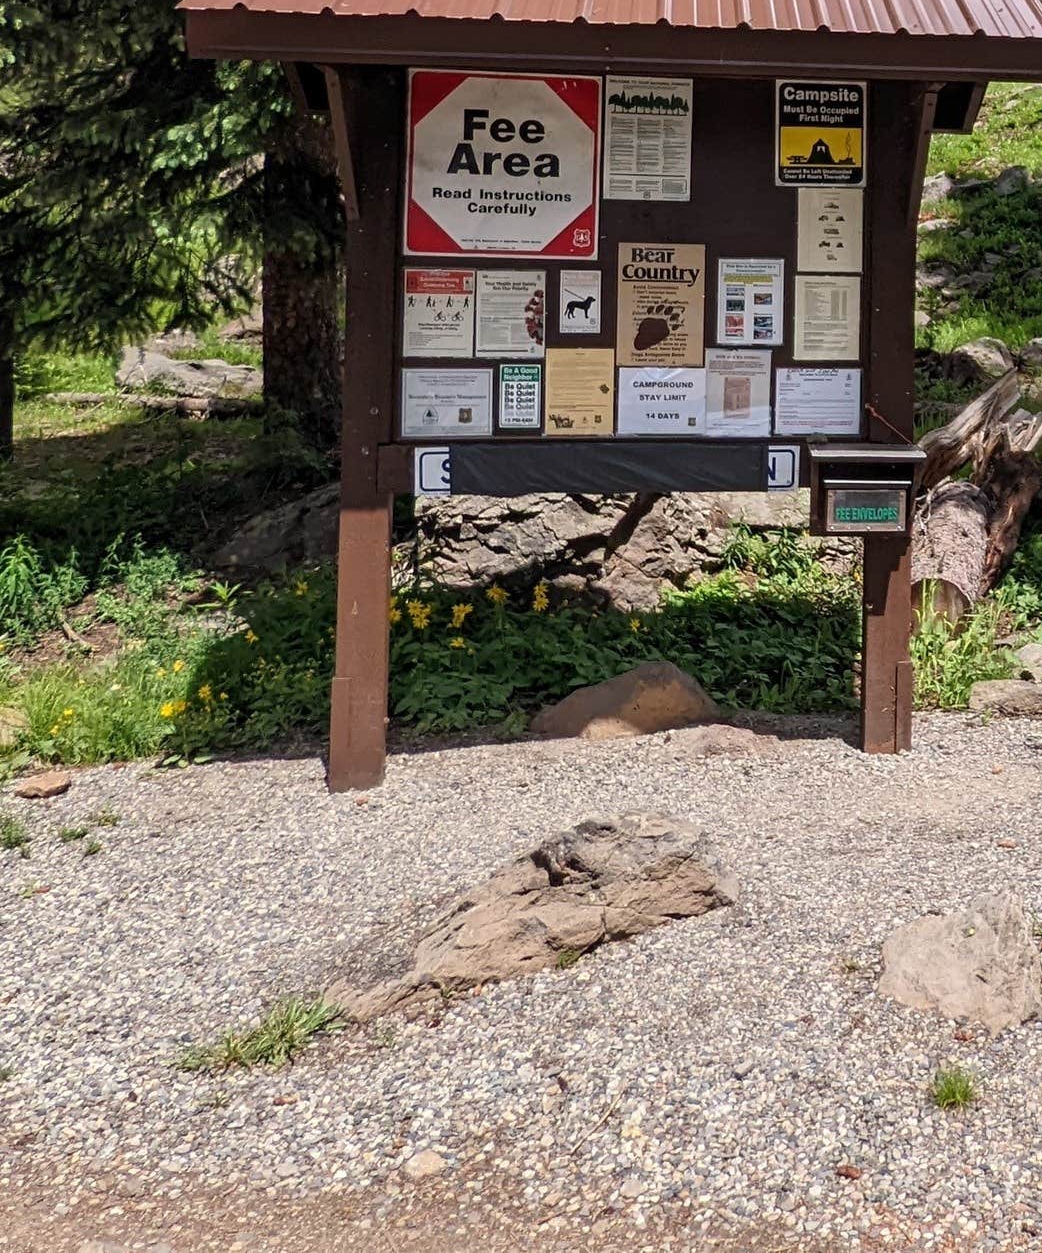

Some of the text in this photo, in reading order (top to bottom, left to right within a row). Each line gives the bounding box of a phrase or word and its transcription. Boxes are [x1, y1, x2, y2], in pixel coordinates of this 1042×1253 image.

[783, 86, 859, 103] Campsite
[783, 105, 860, 115] Must Be Occupied
[463, 109, 545, 143] Fee
[799, 114, 844, 124] First Night
[447, 142, 560, 178] Area
[432, 187, 572, 203] Read Instructions
[467, 202, 537, 217] Carefully
[631, 247, 676, 264] Bear
[622, 264, 700, 287] Country
[516, 403, 535, 411] Quiet
[836, 507, 898, 521] FEE ENVELOPES
